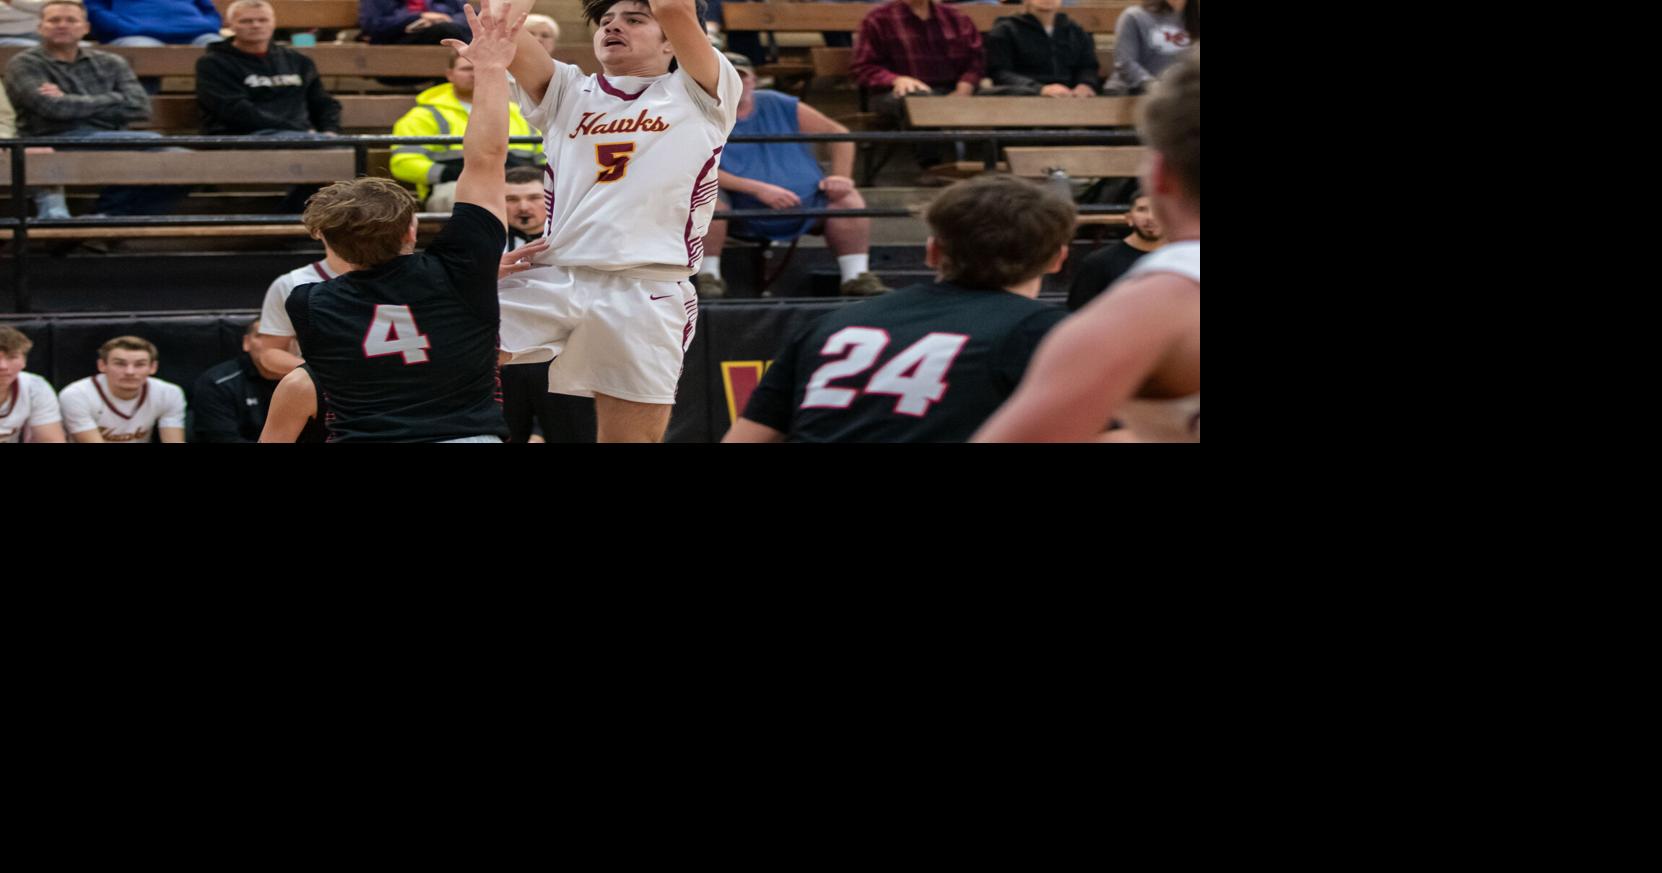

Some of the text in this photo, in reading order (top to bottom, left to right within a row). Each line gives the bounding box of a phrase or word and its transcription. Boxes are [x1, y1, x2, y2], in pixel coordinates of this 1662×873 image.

[569, 109, 670, 139] Hawks
[594, 141, 636, 184] 5
[363, 304, 431, 366] 4
[800, 326, 971, 417] 24
